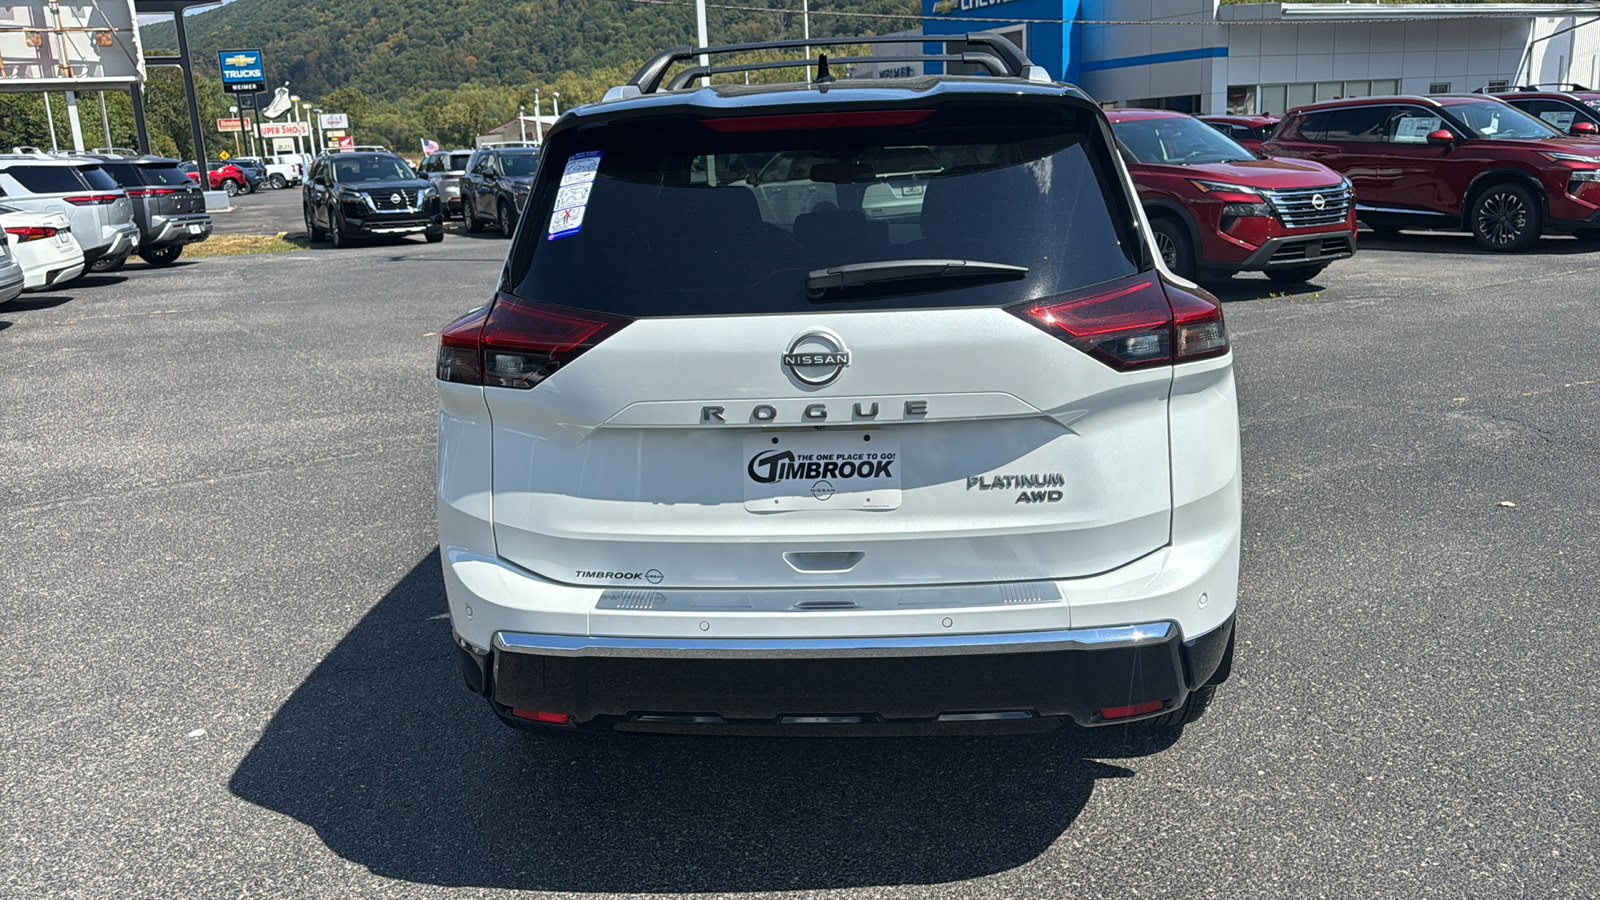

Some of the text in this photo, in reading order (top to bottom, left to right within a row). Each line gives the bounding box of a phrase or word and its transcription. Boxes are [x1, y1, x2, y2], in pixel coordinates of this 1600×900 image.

[223, 69, 262, 79] TRUCKS
[231, 83, 258, 91] WEIMER
[260, 125, 307, 135] UPER SHOS
[785, 354, 848, 365] NISSAN
[703, 400, 929, 421] ROGUE
[836, 453, 864, 461] PLACE
[748, 450, 895, 484] TIMBROOK
[966, 473, 1065, 491] PLATINUM
[1015, 490, 1064, 504] AWD
[575, 570, 644, 580] TIMBROOK
